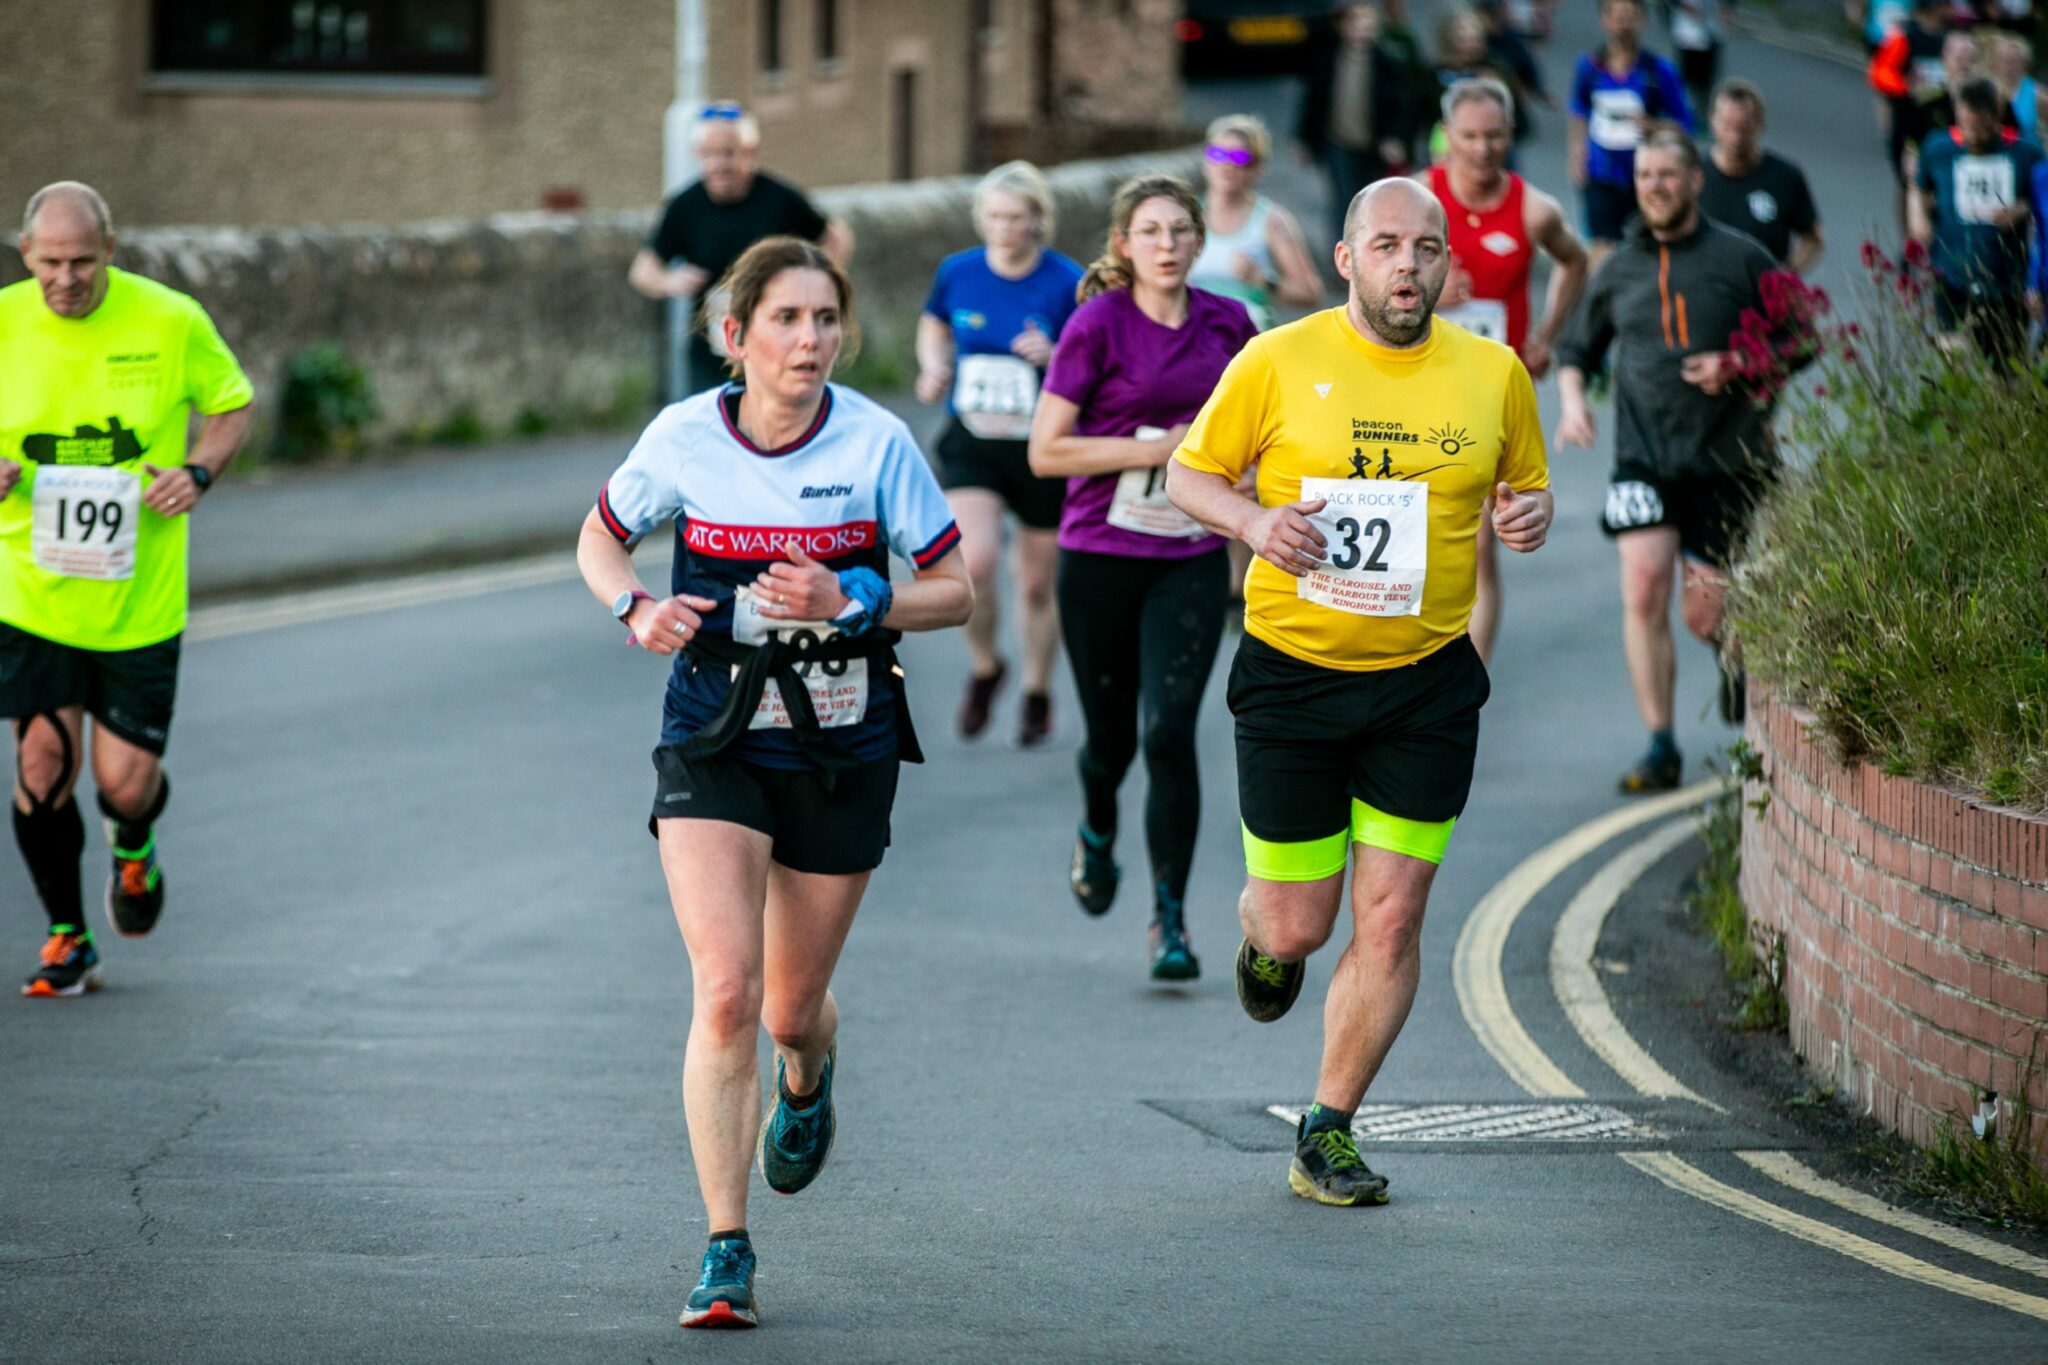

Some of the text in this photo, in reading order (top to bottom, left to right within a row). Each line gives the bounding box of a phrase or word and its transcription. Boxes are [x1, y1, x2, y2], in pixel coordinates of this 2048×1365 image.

[1352, 418, 1403, 430] beacon
[1353, 430, 1419, 443] RUNNERS
[799, 484, 853, 499] Santini
[1358, 493, 1395, 506] ROCK
[57, 497, 122, 544] 199
[690, 526, 867, 555] ATC WARRIORS
[1331, 516, 1391, 572] 32
[1312, 571, 1412, 592] THE CAROUSEL AND
[1310, 581, 1329, 592] THE
[1331, 587, 1380, 601] HARBOUR
[1332, 597, 1386, 612] KINGHORN
[834, 686, 856, 696] AND
